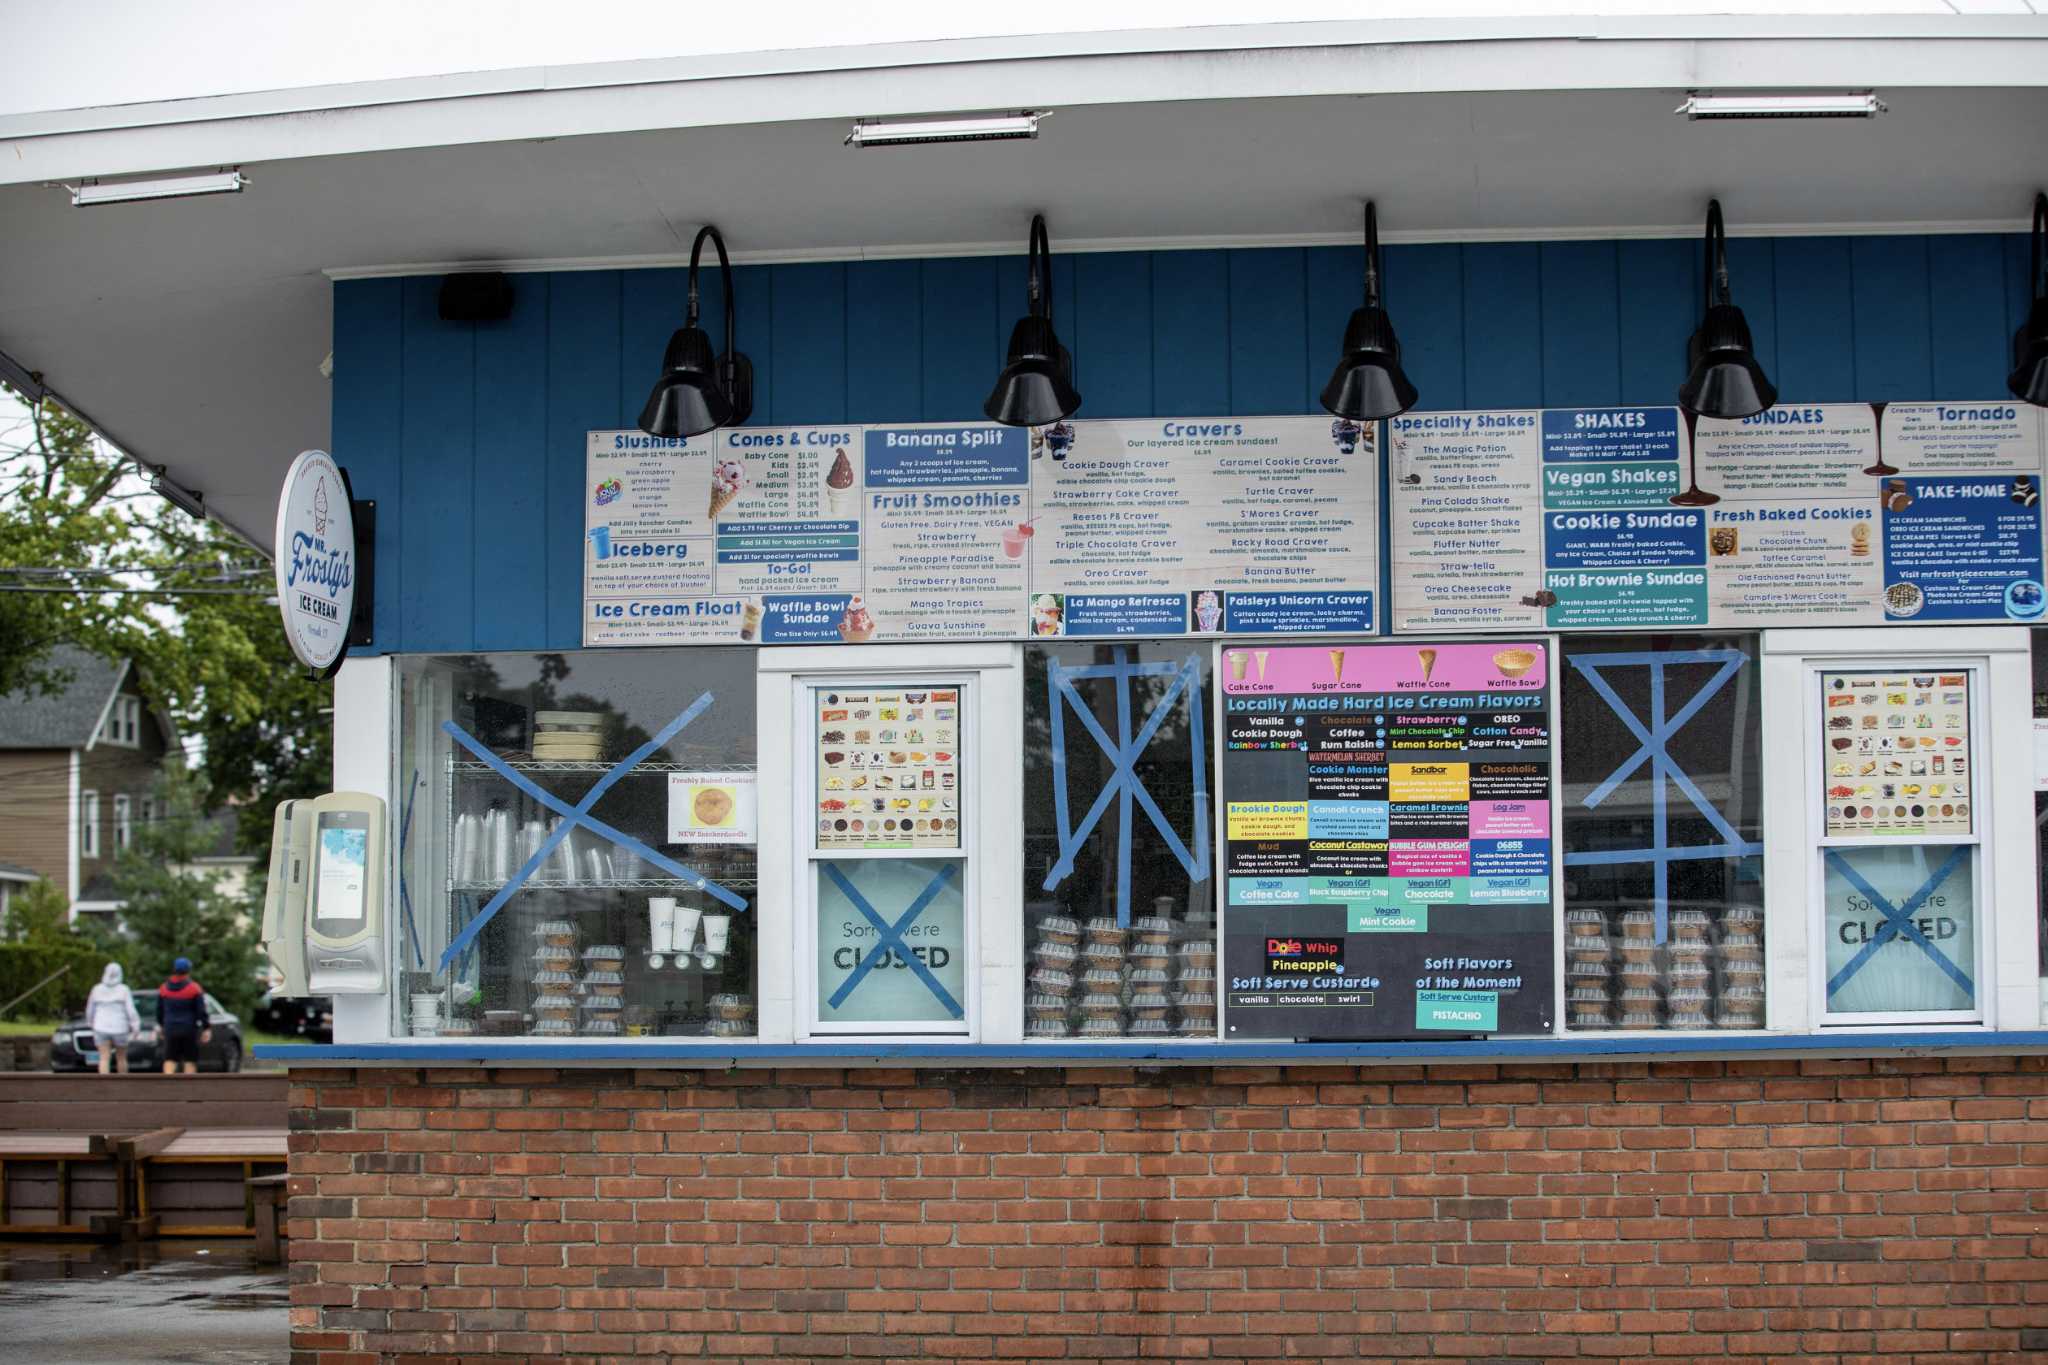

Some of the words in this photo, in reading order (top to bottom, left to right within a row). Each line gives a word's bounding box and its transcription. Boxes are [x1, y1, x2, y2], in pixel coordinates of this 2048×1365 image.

[1937, 407, 2016, 421] Tornado
[1393, 416, 1471, 430] Specialty
[1478, 415, 1535, 427] Shakes
[1575, 413, 1645, 427] SHAKES
[1164, 422, 1243, 437] Cravers
[615, 434, 687, 448] Slushies
[729, 433, 784, 447] Cones
[790, 432, 800, 446] &
[807, 432, 851, 447] Cups
[887, 433, 956, 447] Banana
[961, 431, 1003, 449] Split
[1128, 440, 1144, 448] Our
[1147, 439, 1184, 448] layered
[1186, 438, 1200, 446] ice
[1204, 438, 1234, 446] cream
[1236, 437, 1278, 446] sundaes!
[1062, 461, 1097, 469] Cookie
[1100, 461, 1131, 470] Dough
[1134, 460, 1169, 468] Craver
[1434, 475, 1463, 484] Sandy
[1466, 475, 1497, 483] Beach
[1547, 470, 1605, 487] Vegan
[1611, 469, 1677, 484] Shakes
[1916, 485, 2006, 499] TAKE-HOME
[873, 494, 917, 509] Fruit
[923, 492, 1021, 508] Smoothies
[1241, 510, 1280, 518] S'Mores
[1283, 509, 1320, 517] Craver
[1713, 510, 1755, 522] Fresh
[1759, 509, 1806, 521] Baked
[1811, 508, 1872, 520] Cookies
[1553, 515, 1621, 530] Cookie
[1626, 513, 1698, 528] Sundae
[917, 533, 977, 543] Strawberry
[1056, 541, 1085, 550] Triple
[1087, 540, 1138, 549] Chocolate
[1141, 539, 1177, 548] Craver
[1433, 541, 1466, 549] Fluffer
[1468, 540, 1501, 548] Nutter
[612, 542, 688, 558] Iceberg
[288, 530, 352, 598] Frosty's
[899, 555, 948, 564] Pineapple
[767, 563, 811, 574] To-Go!
[898, 577, 957, 586] Strawberry
[960, 577, 996, 585] Banana
[1549, 574, 1576, 588] Hot
[1579, 573, 1644, 587] Brownie
[1646, 572, 1704, 586] Sundae
[1424, 585, 1448, 593] Oreo
[1451, 584, 1512, 593] Cheesecake
[1070, 598, 1089, 607] La
[1092, 597, 1125, 608] Mango
[1128, 597, 1180, 606] Refresca
[1229, 595, 1277, 606] Paisleys
[1280, 594, 1324, 605] Unicorn
[1327, 594, 1369, 604] Craver
[300, 595, 311, 611] ICE
[313, 599, 337, 620] CREAM
[595, 602, 624, 617] Ice
[629, 602, 691, 617] Cream
[696, 600, 742, 615] Float
[768, 602, 811, 613] Waffle
[815, 602, 845, 612] Bowl
[783, 613, 830, 624] Sundae
[1228, 683, 1249, 691] Cake
[1252, 683, 1274, 691] Cone
[1312, 682, 1337, 691] Sugar
[1228, 697, 1287, 712] Locally
[1292, 697, 1339, 710] Made
[1344, 696, 1384, 709] Hard
[1388, 696, 1414, 709] Ice
[1419, 695, 1474, 708] Cream
[1478, 694, 1541, 707] Flavors
[1249, 717, 1284, 726] Vanilla
[1320, 716, 1372, 725] Chocolate
[1396, 715, 1458, 725] Strawberry
[1493, 715, 1521, 723] OREO
[1232, 729, 1267, 738] Cookie
[1270, 729, 1303, 739] Dough
[1329, 728, 1365, 737] Coffee
[1408, 727, 1446, 735] Chocolate
[1448, 727, 1465, 735] Chip
[1473, 727, 1507, 735] Cotton
[1509, 727, 1542, 737] Candy
[1228, 741, 1268, 750] Rainbow
[1270, 741, 1307, 749] Sherbet
[1321, 741, 1342, 750] Rum
[1344, 740, 1375, 749] Raisin
[1392, 740, 1425, 749] Lemon
[1428, 740, 1463, 748] Sorbet
[1468, 740, 1494, 748] Sugar
[1518, 738, 1548, 746] Vanilla
[1309, 765, 1344, 774] Cookie
[1347, 764, 1388, 773] Monster
[1411, 766, 1447, 774] Sandbar
[1481, 765, 1537, 773] Chocoholic
[1390, 803, 1429, 811] Caramel
[1432, 803, 1468, 811] Brownie
[1257, 880, 1283, 888] Vegan
[1240, 890, 1273, 899] Coffee
[1275, 890, 1299, 898] Cake
[1404, 890, 1454, 899] Chocolate
[1374, 907, 1400, 916] Vegan
[1360, 917, 1380, 926] Mint
[1382, 917, 1416, 926] Cookie
[843, 922, 882, 939] Sorr
[1839, 917, 1957, 944] CLED
[1268, 939, 1302, 953] Dole
[1307, 943, 1338, 954] Whip
[1272, 960, 1336, 972] Pineapple
[1425, 958, 1455, 969] Soft
[1458, 958, 1513, 969] Flavors
[1232, 977, 1261, 989] Soft
[1265, 977, 1308, 988] Serve
[1312, 977, 1370, 988] Custard
[1416, 976, 1432, 989] of
[1436, 976, 1460, 988] the
[1463, 976, 1521, 988] Moment
[1239, 996, 1269, 1004] vanilla
[1280, 995, 1324, 1003] chocolate
[1338, 995, 1360, 1003] swirl
[1432, 1011, 1482, 1020] PISTACHIO
